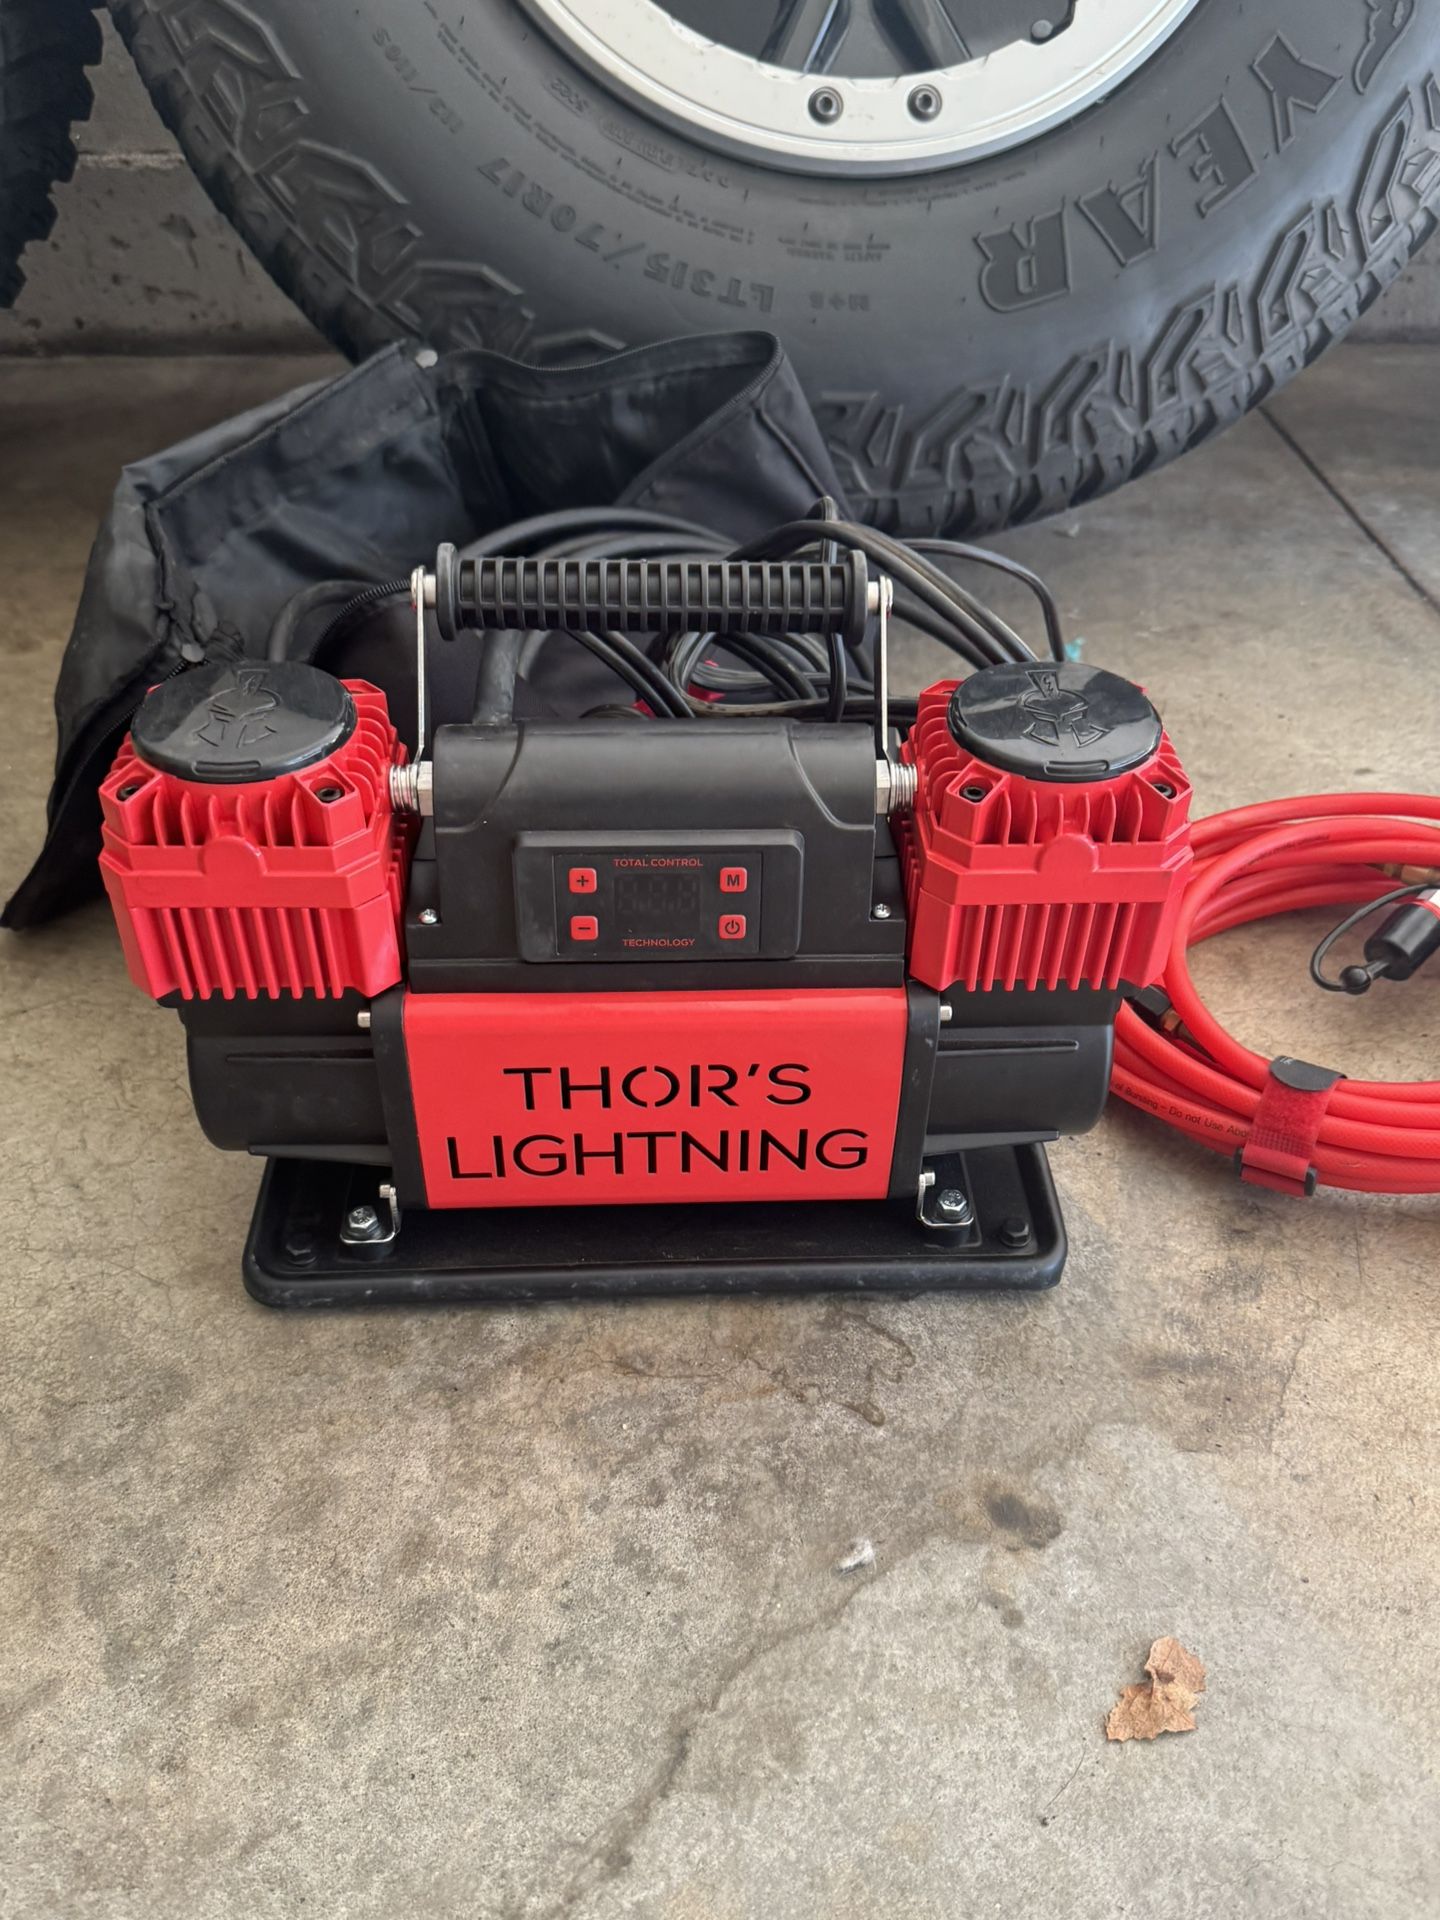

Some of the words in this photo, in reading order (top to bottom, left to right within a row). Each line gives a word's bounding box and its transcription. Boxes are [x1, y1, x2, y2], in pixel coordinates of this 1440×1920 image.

[973, 30, 1343, 312] YEAR
[477, 156, 776, 314] LT315/70R17
[614, 857, 649, 868] TOTAL
[650, 857, 703, 867] CONTROL
[726, 874, 741, 887] M
[622, 938, 696, 948] TECHNOLOGY
[502, 1063, 812, 1111] THOR'S
[1168, 1105, 1183, 1118] Do
[1184, 1112, 1202, 1124] not
[1204, 1117, 1224, 1131] Use
[446, 1128, 869, 1180] LIGHTNING
